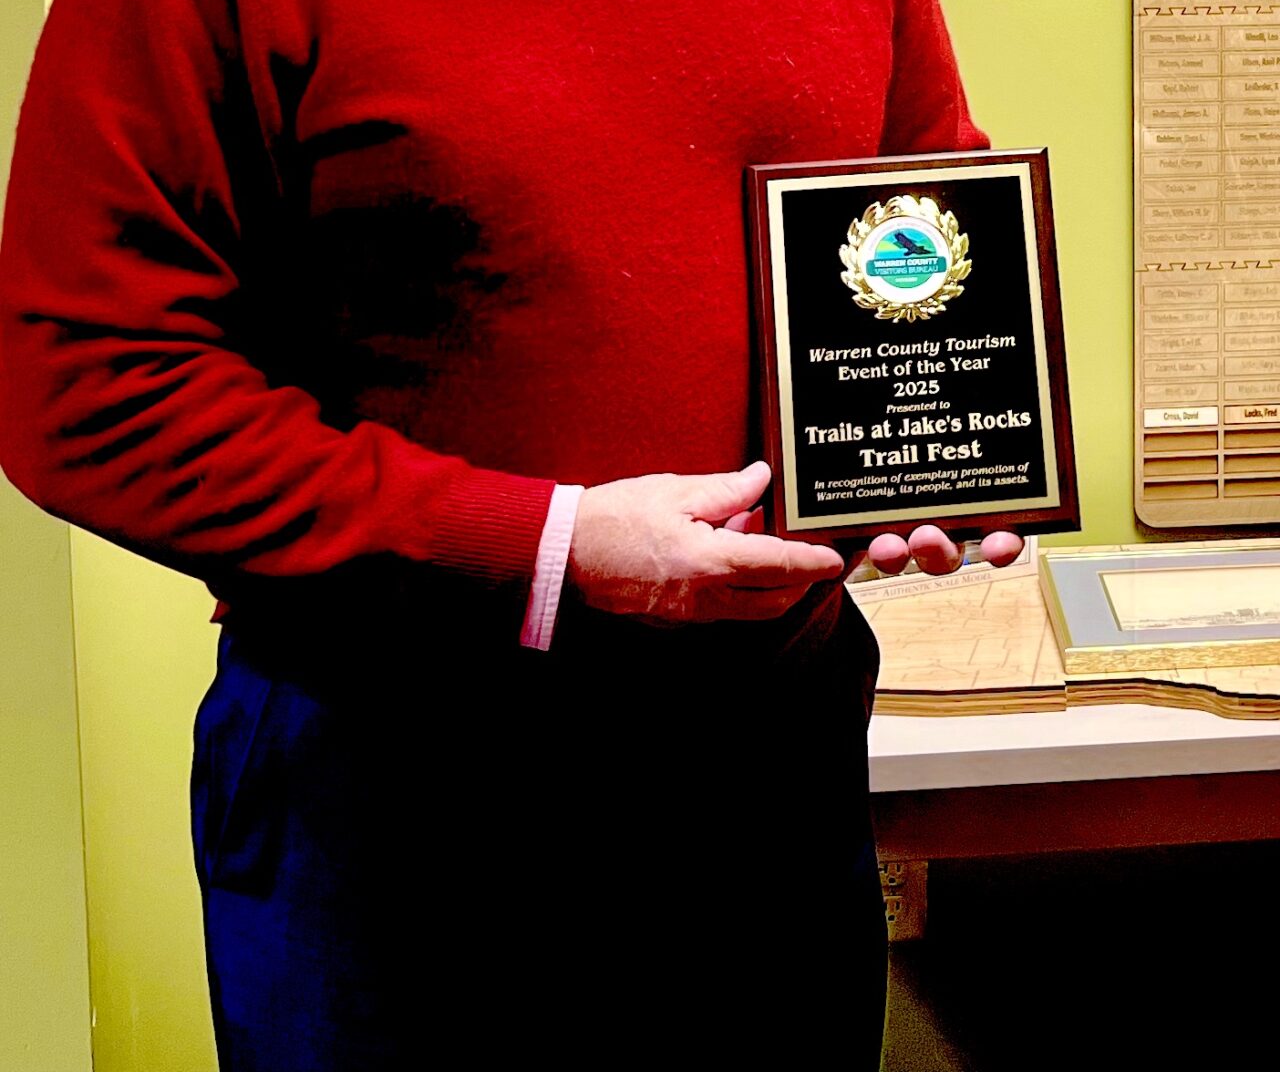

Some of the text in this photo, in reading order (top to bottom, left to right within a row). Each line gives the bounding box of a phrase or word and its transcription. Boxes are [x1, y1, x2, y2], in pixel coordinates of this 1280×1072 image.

[809, 334, 1017, 362] Warren County Tourism
[838, 355, 991, 381] Event of the Year
[893, 380, 940, 397] 2025
[886, 400, 951, 414] Presented to
[805, 409, 1032, 445] Trails at Jake's Rocks
[859, 439, 983, 468] Trail Fest
[814, 462, 1029, 490] In recognition of exemplary promotion of
[816, 489, 853, 501] Warren
[956, 478, 976, 489] and
[882, 581, 930, 597] AUTHENTIC
[935, 577, 960, 589] SCALE
[961, 572, 993, 584] MODEL
